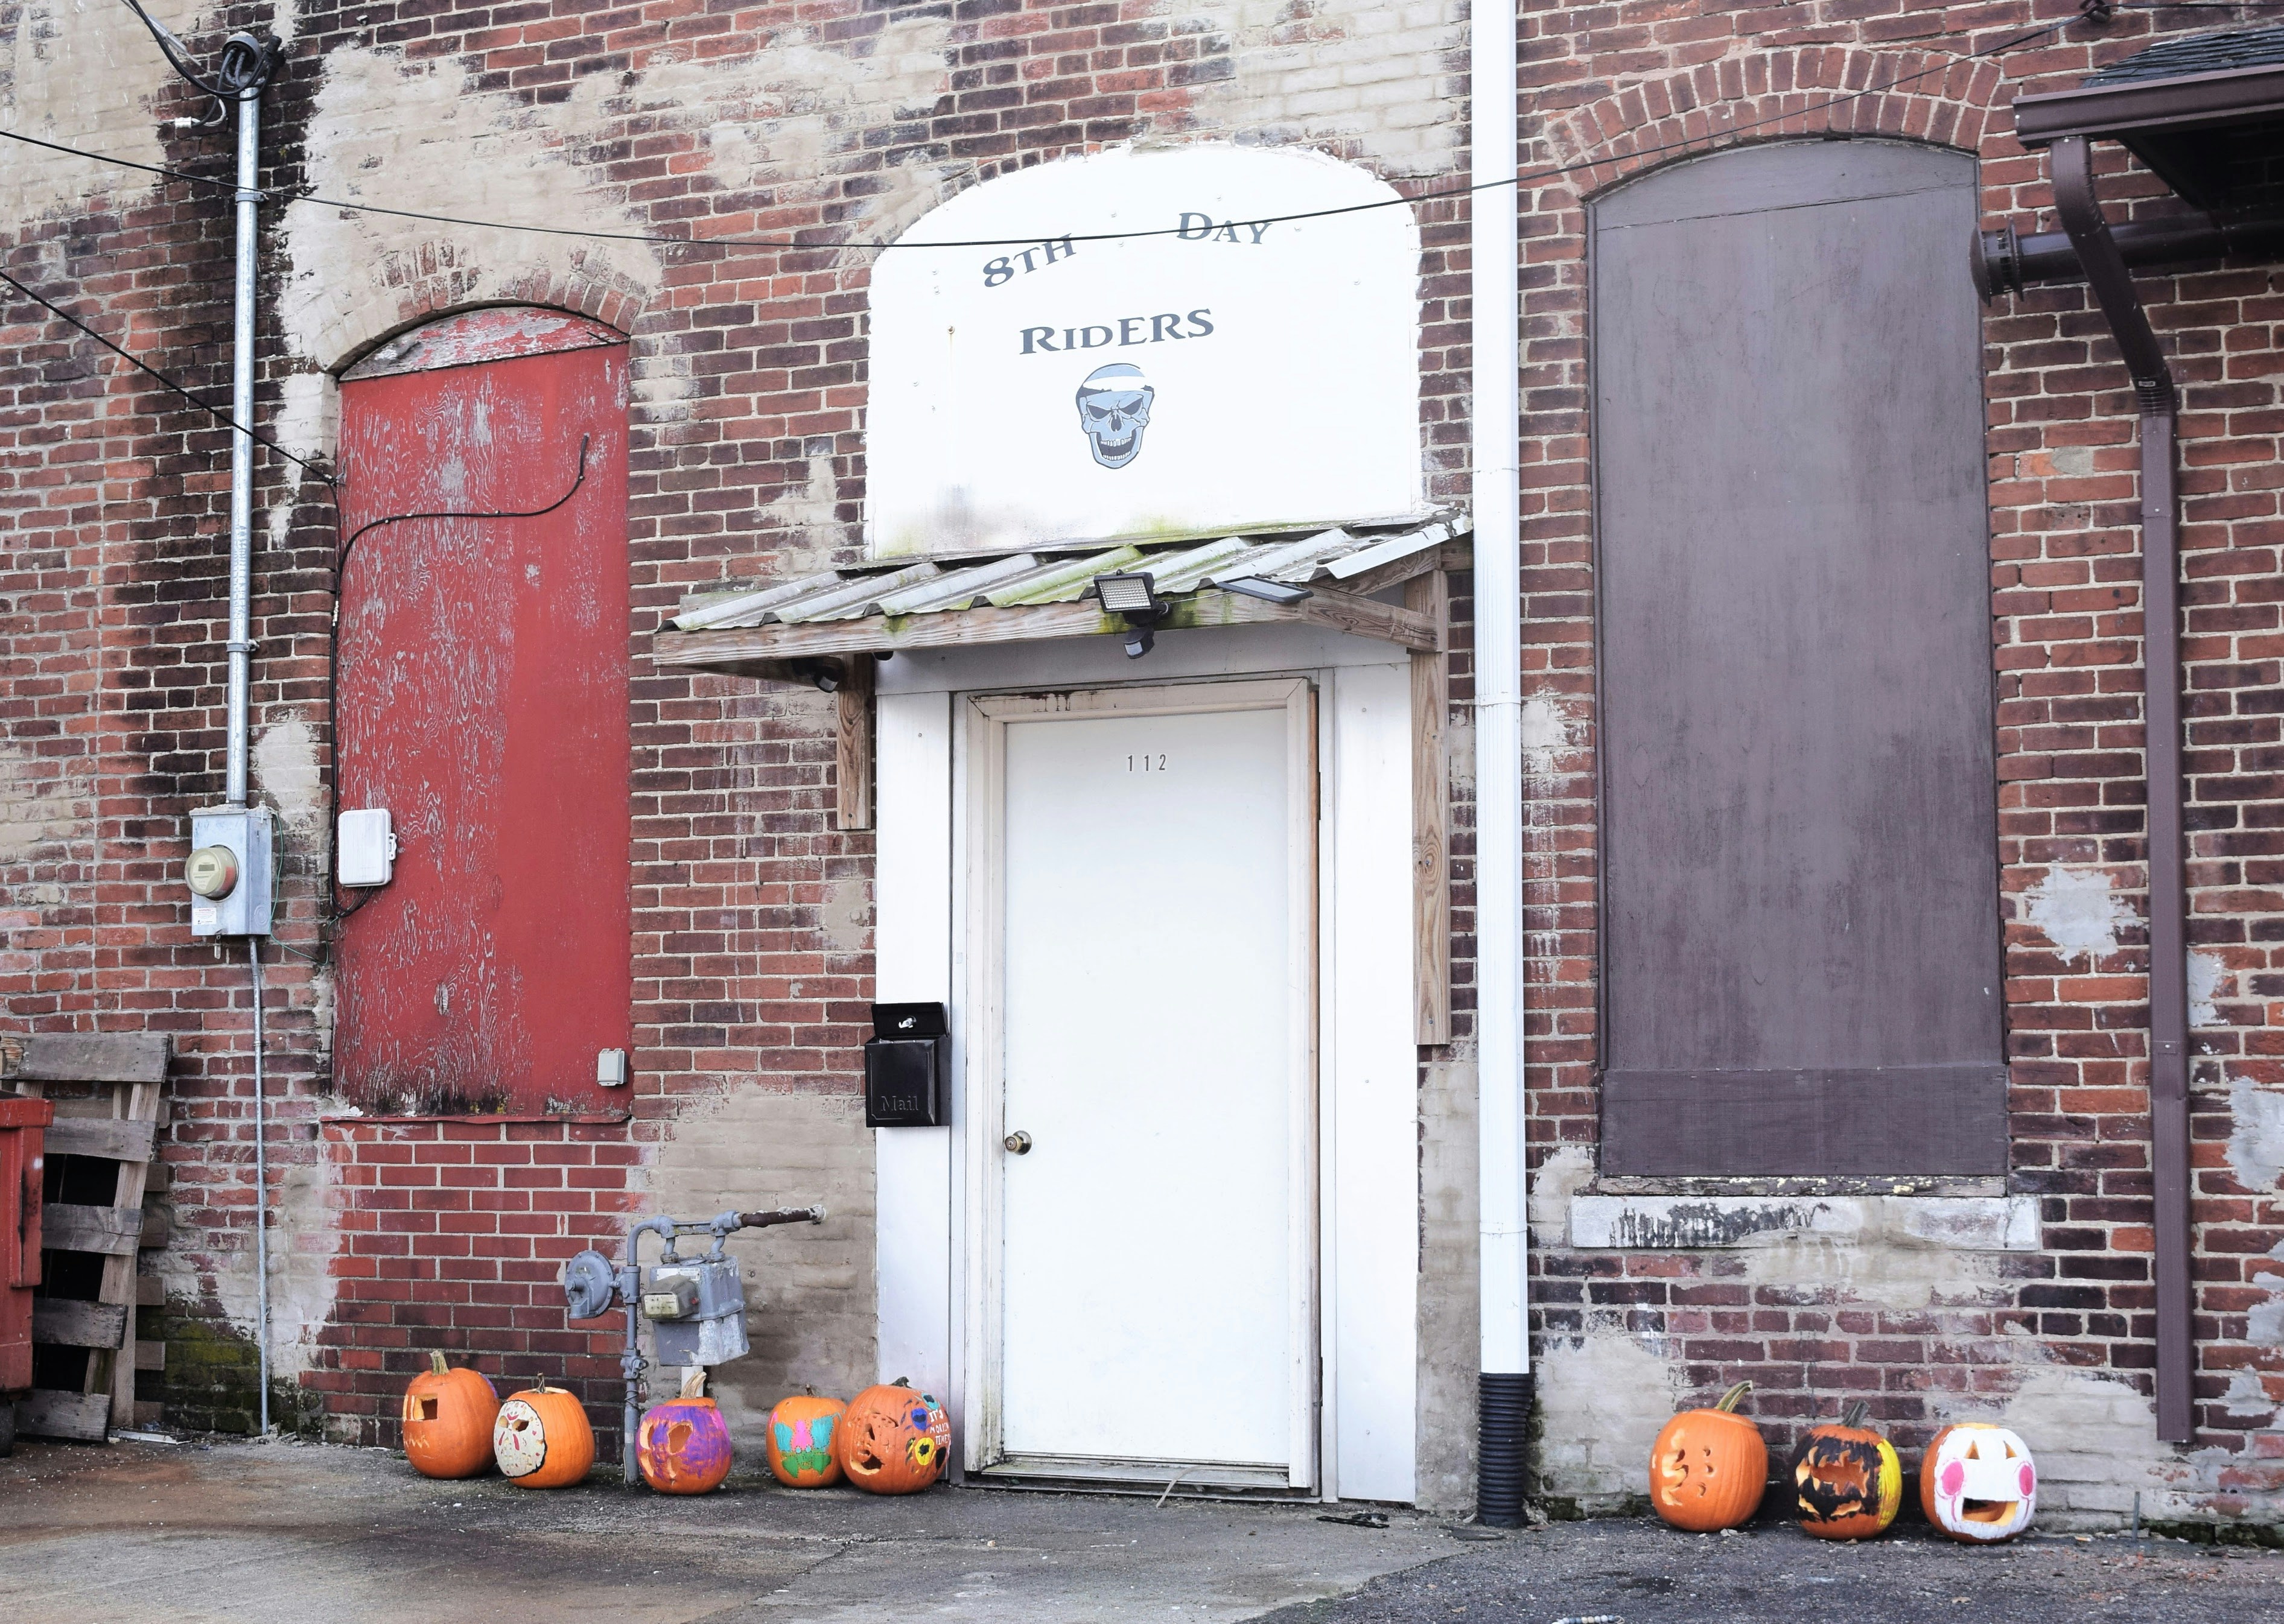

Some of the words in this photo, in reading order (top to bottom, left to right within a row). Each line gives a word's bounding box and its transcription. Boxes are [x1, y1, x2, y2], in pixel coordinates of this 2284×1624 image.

[982, 233, 1077, 288] 8TH
[1175, 212, 1273, 244] DAY
[1019, 308, 1214, 355] RIDERS
[880, 1096, 918, 1111] Mail
